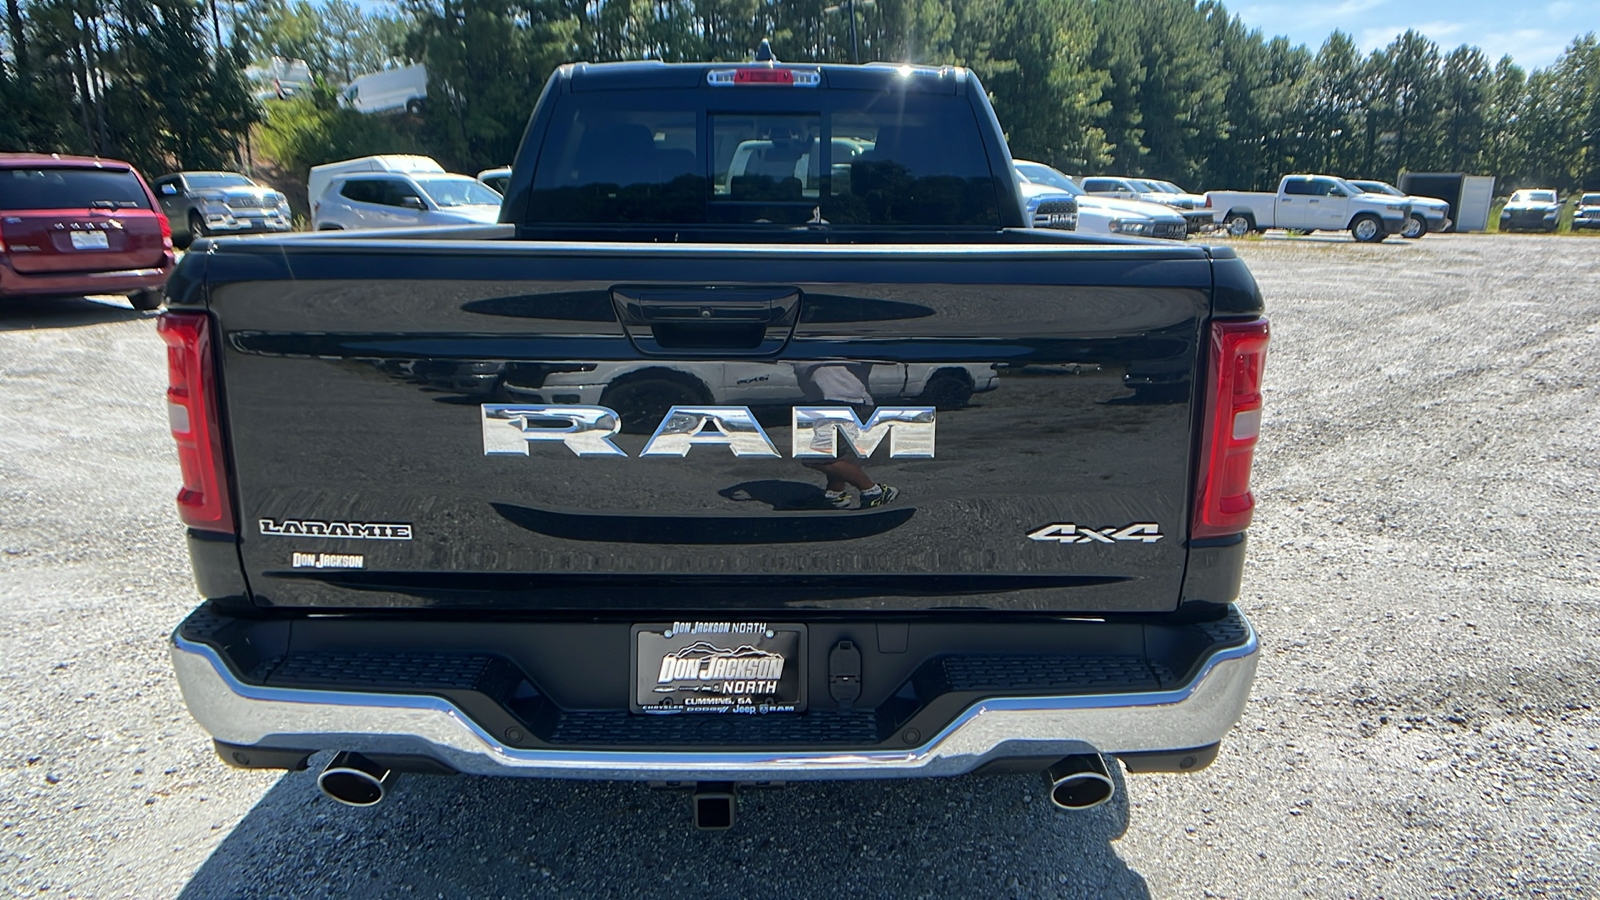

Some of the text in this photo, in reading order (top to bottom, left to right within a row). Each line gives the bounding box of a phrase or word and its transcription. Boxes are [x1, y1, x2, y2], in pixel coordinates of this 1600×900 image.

[480, 403, 937, 459] RAM
[258, 519, 413, 540] LARAMIE
[731, 622, 767, 634] NORTH
[722, 681, 778, 695] NORTH
[737, 697, 753, 705] GA
[732, 704, 757, 715] Jeep
